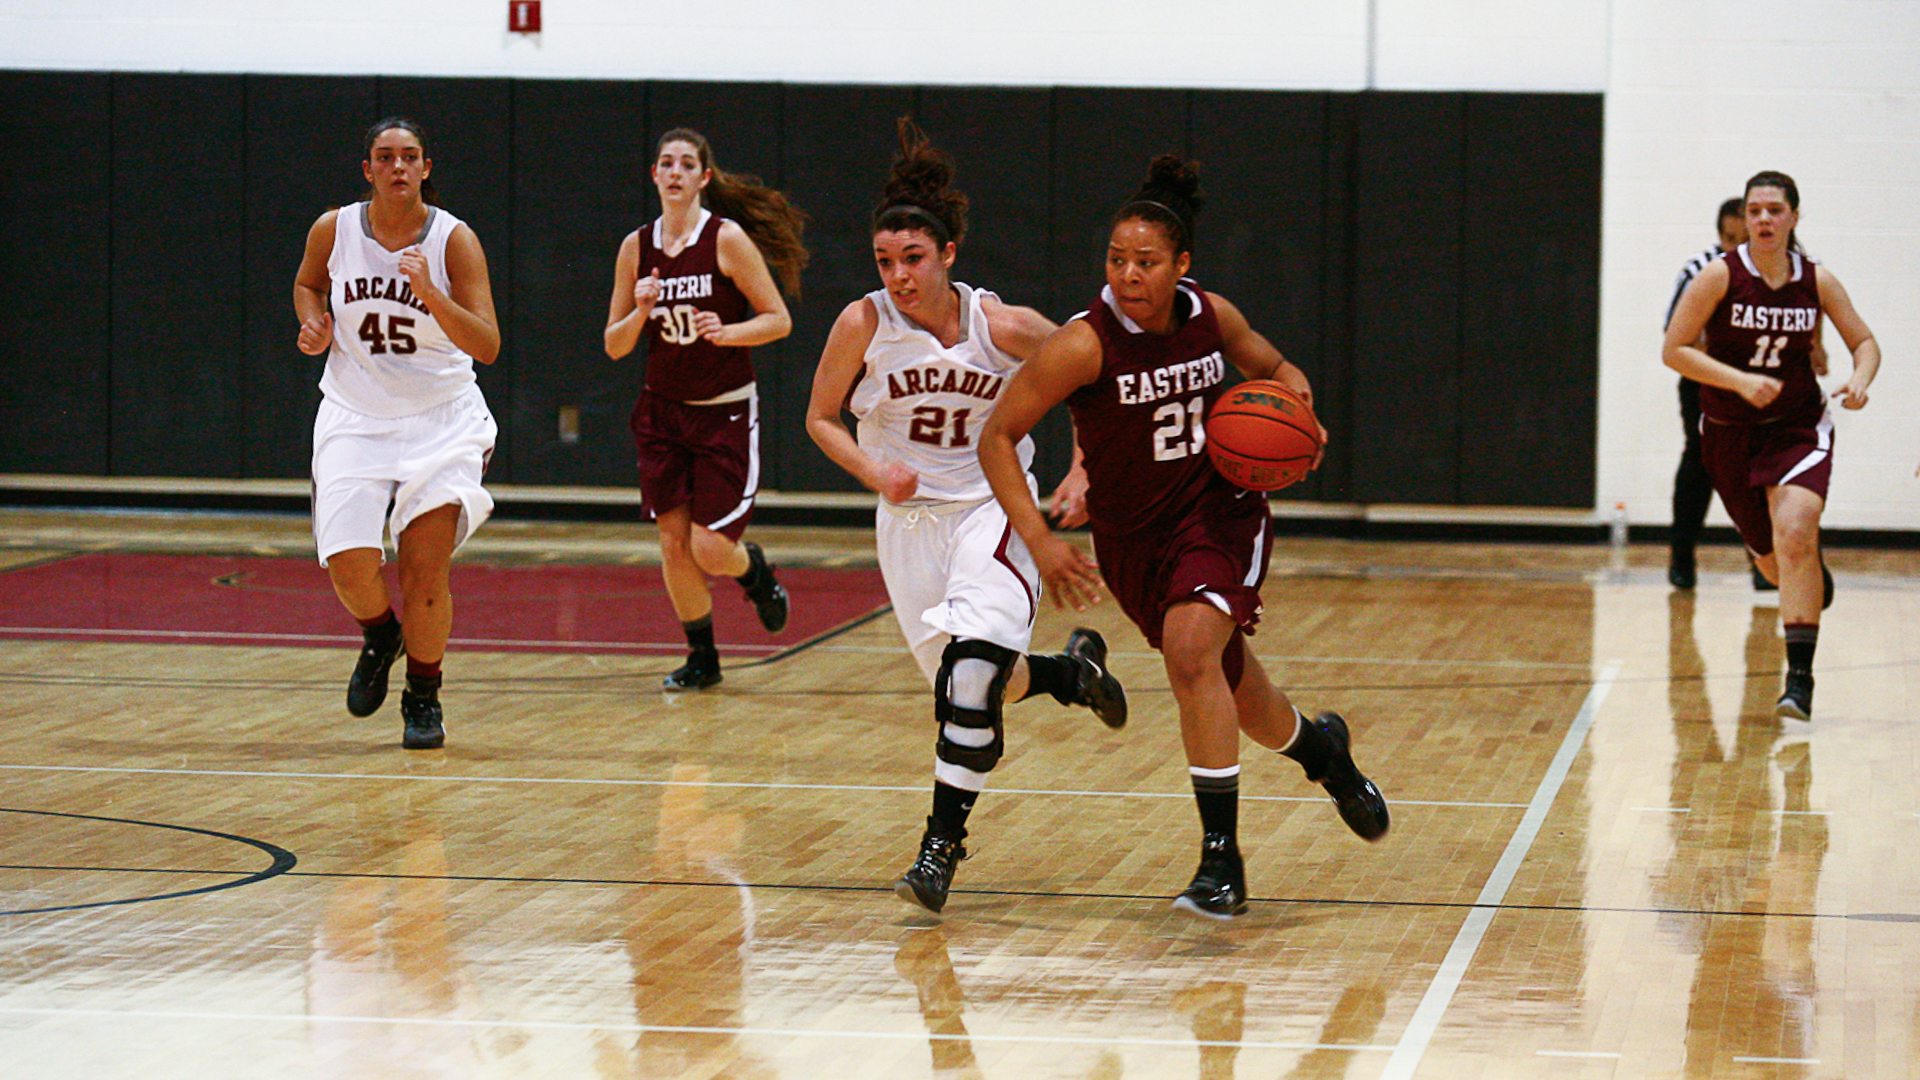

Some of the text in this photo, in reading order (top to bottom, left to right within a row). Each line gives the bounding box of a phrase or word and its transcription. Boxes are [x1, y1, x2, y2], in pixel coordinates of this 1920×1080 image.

[656, 273, 713, 302] STERN
[358, 312, 418, 355] 45
[650, 304, 699, 346] 30
[1731, 303, 1818, 332] EASTERN
[1748, 335, 1789, 368] 11
[887, 367, 1004, 400] ARCADIA
[909, 406, 972, 448] 21
[1152, 395, 1207, 462] 21
